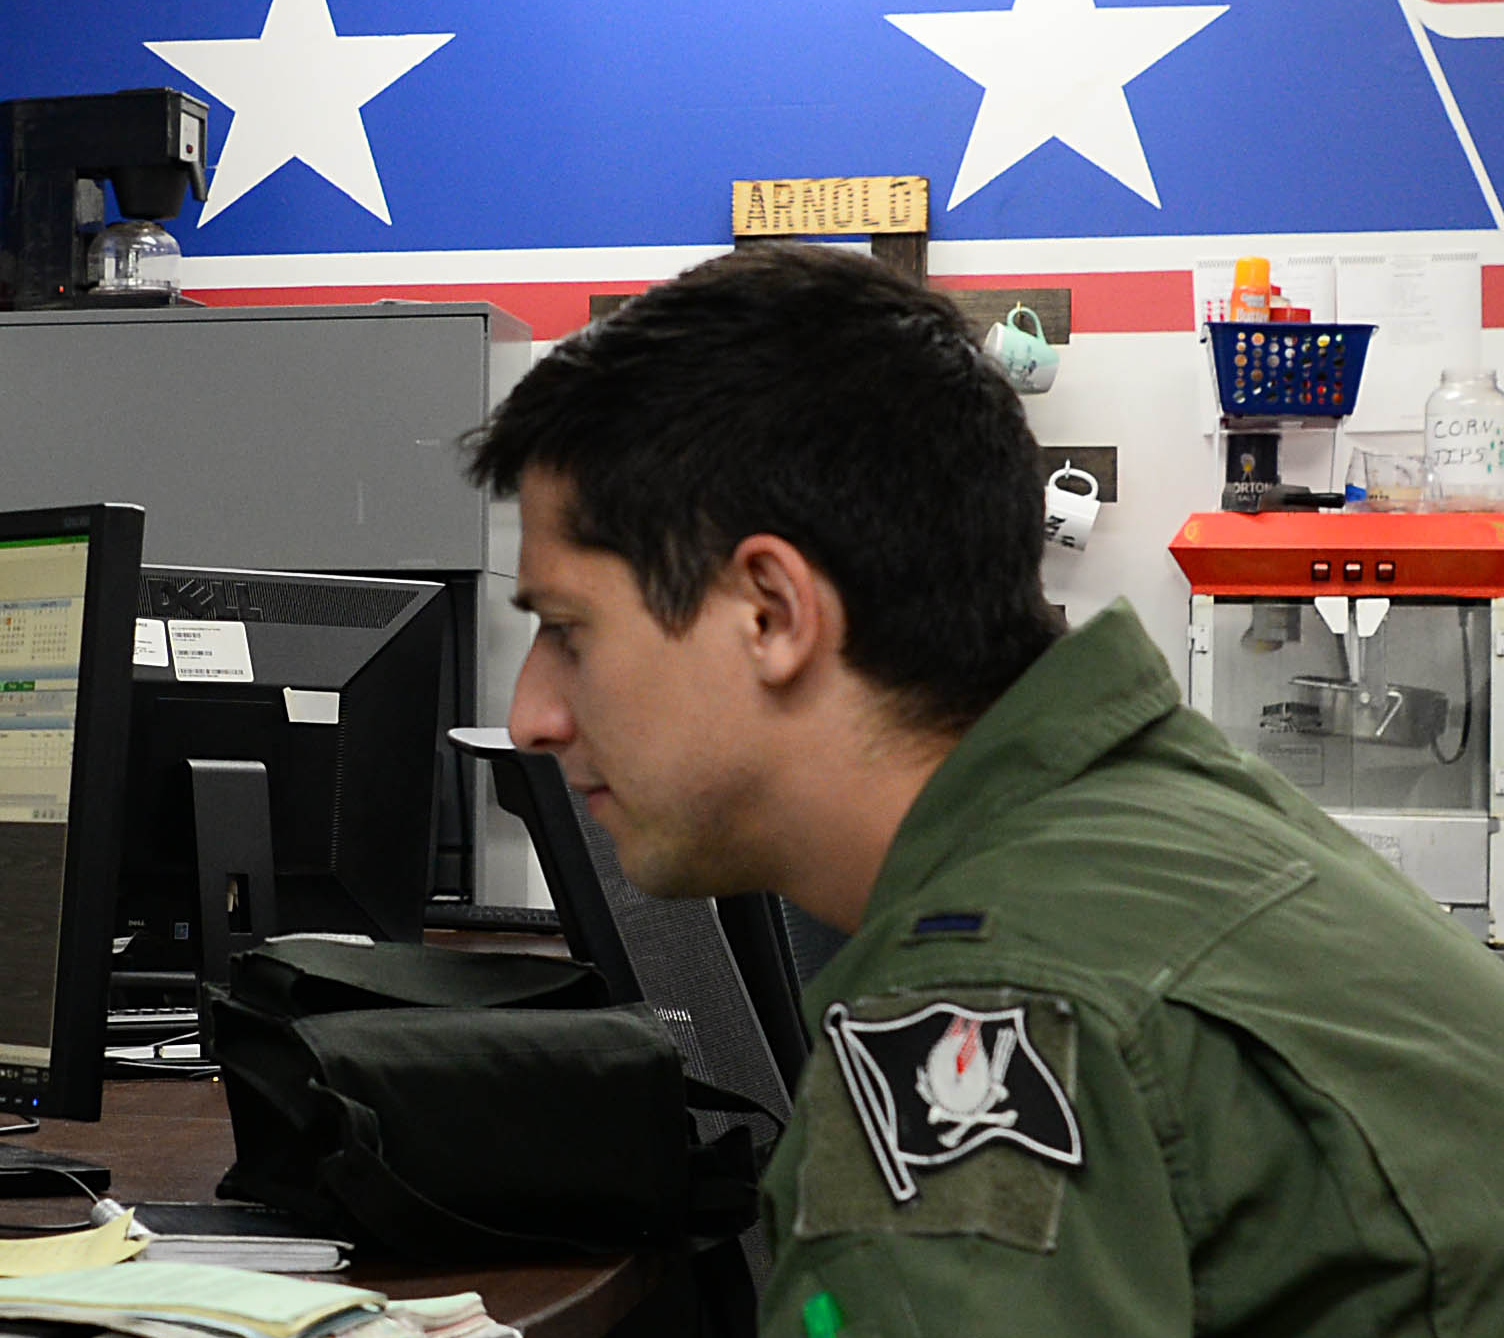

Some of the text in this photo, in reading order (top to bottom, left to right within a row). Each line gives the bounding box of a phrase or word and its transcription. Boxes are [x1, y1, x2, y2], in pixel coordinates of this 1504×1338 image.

[745, 179, 912, 230] ARNOLD
[1434, 418, 1492, 439] CORN
[145, 578, 264, 621] DELL
